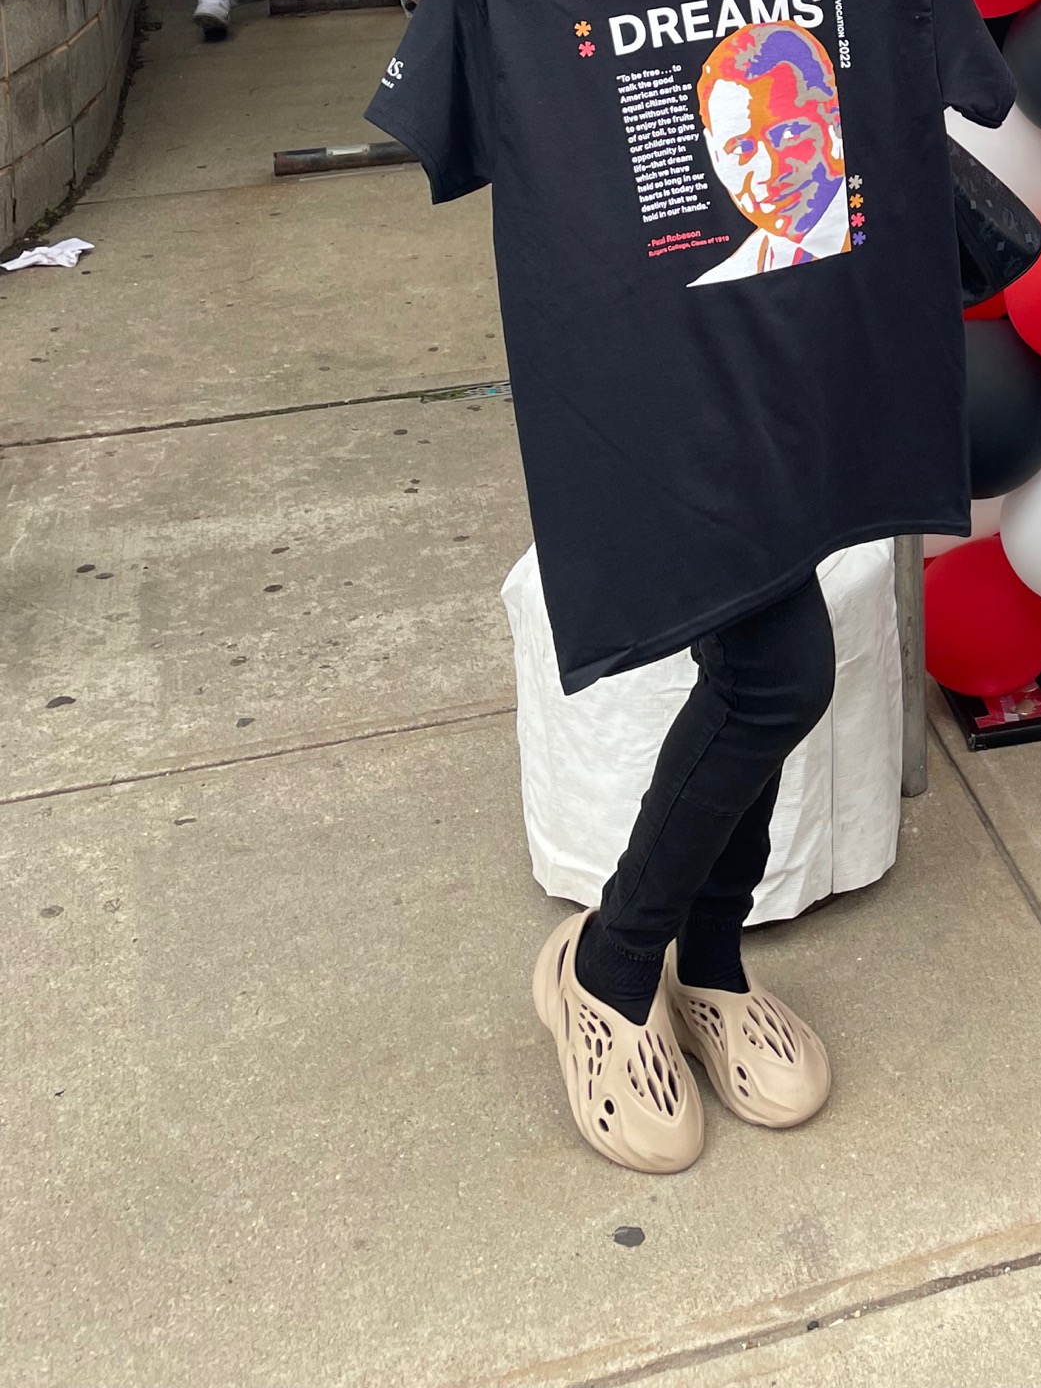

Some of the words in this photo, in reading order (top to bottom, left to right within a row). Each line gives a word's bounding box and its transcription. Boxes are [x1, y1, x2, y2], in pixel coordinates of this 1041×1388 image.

[838, 39, 851, 69] 2022
[618, 83, 637, 93] walk
[638, 81, 651, 89] the
[653, 75, 674, 88] good
[631, 73, 642, 81] be
[643, 69, 660, 78] free
[620, 90, 658, 104] American
[660, 85, 681, 95] earth
[622, 102, 644, 113] equal
[645, 99, 678, 108] citizens,
[623, 115, 638, 123] live
[639, 108, 669, 119] without
[636, 121, 657, 131] enjoy
[658, 118, 671, 126] the
[672, 113, 694, 123] fruits
[628, 135, 636, 143] of
[638, 133, 650, 141] our
[667, 127, 676, 135] to
[678, 124, 695, 133] give
[630, 144, 644, 154] our
[644, 138, 676, 150] children
[677, 133, 699, 142] every
[632, 147, 677, 163] opportunity
[667, 154, 693, 165] dream
[635, 171, 657, 183] which
[658, 169, 669, 177] we
[670, 165, 690, 175] have
[637, 183, 654, 193] held
[654, 181, 664, 189] so
[664, 176, 682, 187] long
[683, 174, 691, 182] in
[639, 190, 663, 203] hearts
[663, 189, 670, 197] is
[671, 185, 694, 195] today
[695, 182, 708, 190] the
[641, 201, 667, 213] destiny
[668, 197, 685, 206] that
[685, 194, 698, 202] we
[643, 212, 658, 223] hold
[667, 207, 680, 217] our
[651, 237, 666, 247] Paul
[666, 231, 701, 242] Robeson
